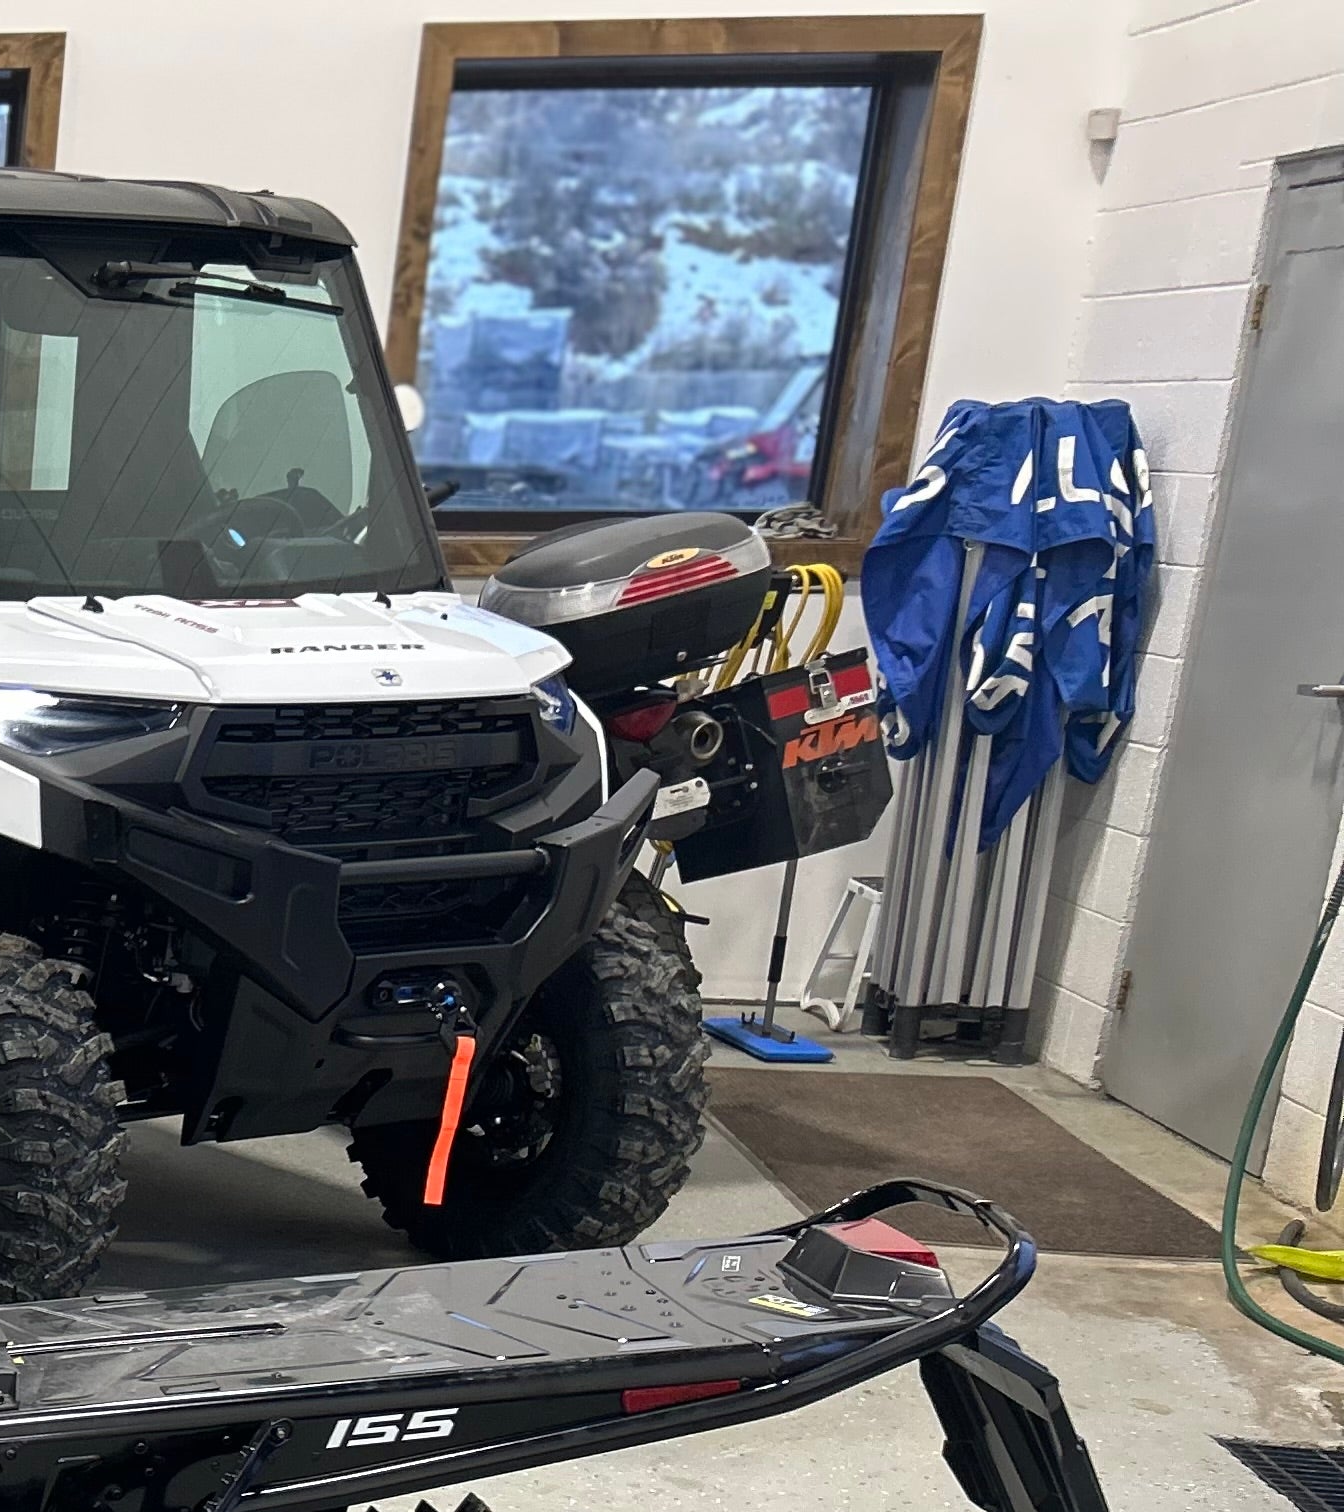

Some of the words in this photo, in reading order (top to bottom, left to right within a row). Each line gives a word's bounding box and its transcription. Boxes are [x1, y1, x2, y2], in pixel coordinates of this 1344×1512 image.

[270, 643, 425, 654] RANGER
[309, 740, 457, 769] POLARIS
[782, 714, 879, 769] KTM
[325, 1407, 460, 1449] 155
